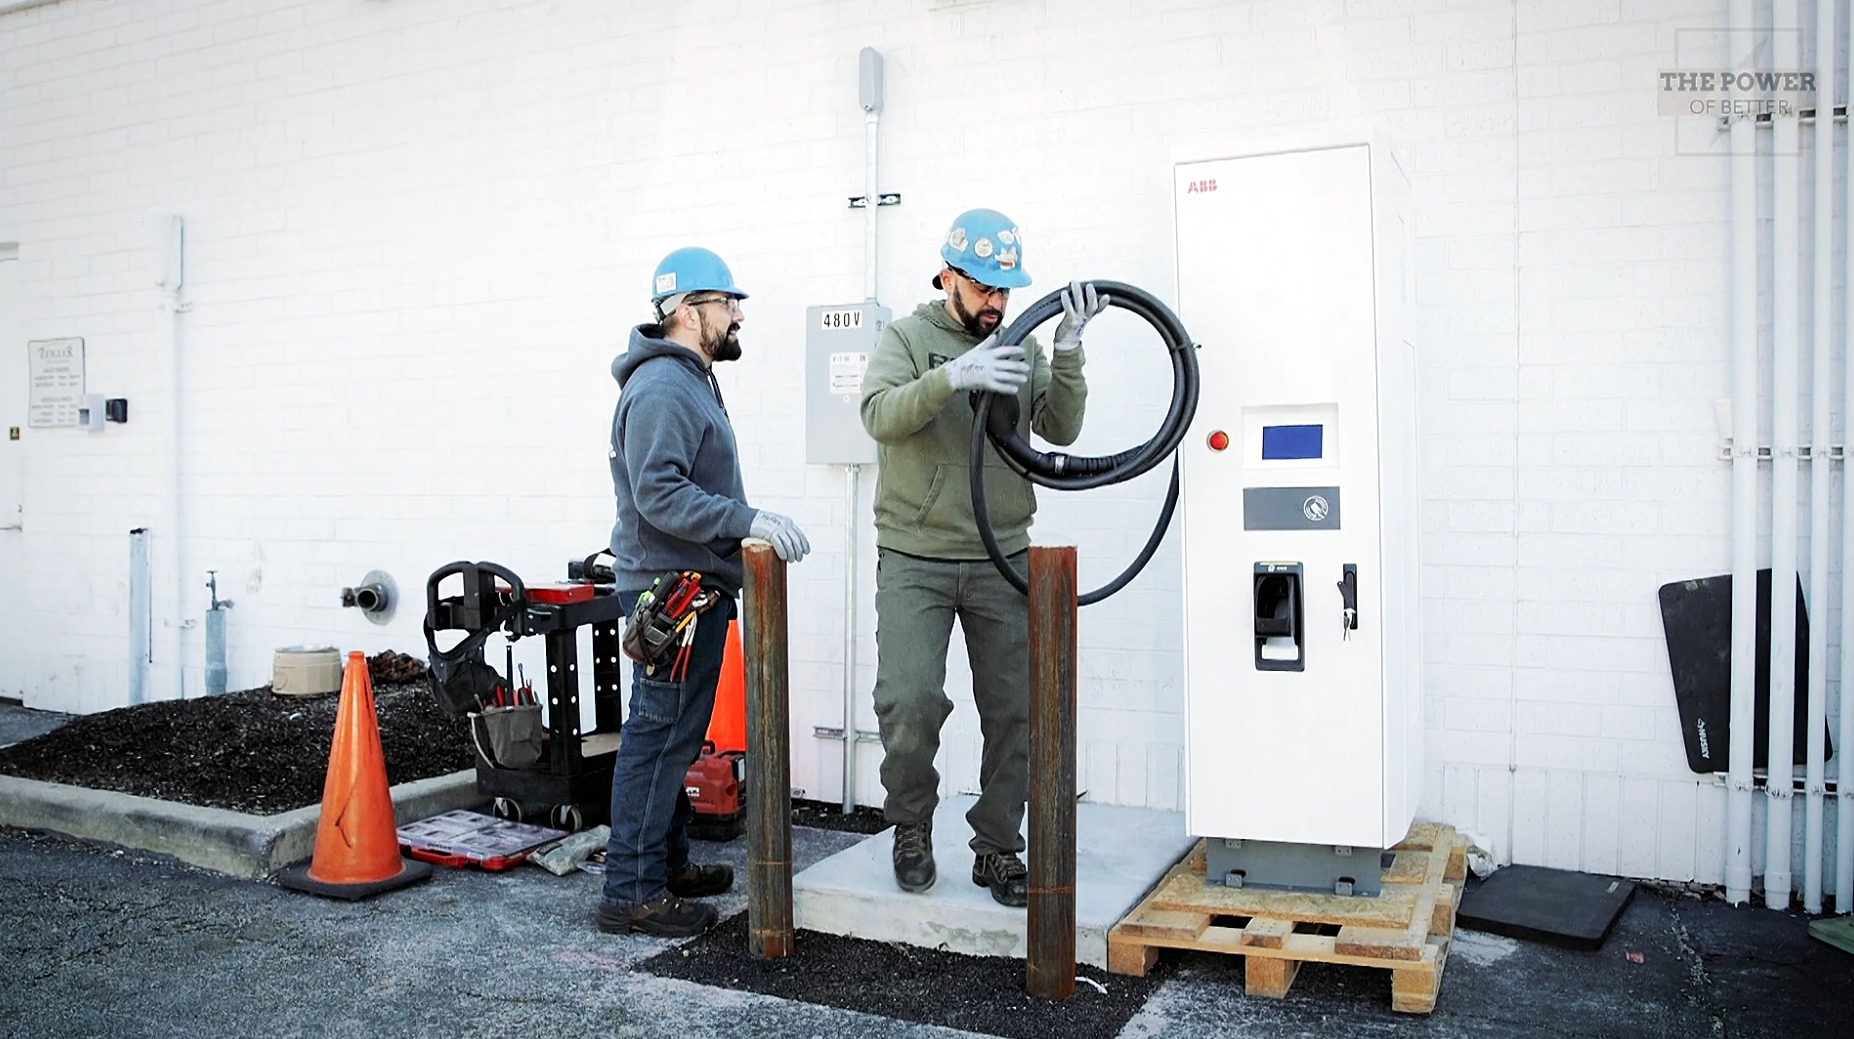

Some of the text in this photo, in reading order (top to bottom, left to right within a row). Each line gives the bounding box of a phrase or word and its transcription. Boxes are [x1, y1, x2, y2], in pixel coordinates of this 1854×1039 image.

[1187, 179, 1217, 194] ABB
[823, 311, 860, 328] 480V
[1698, 728, 1710, 759] HUSKY
